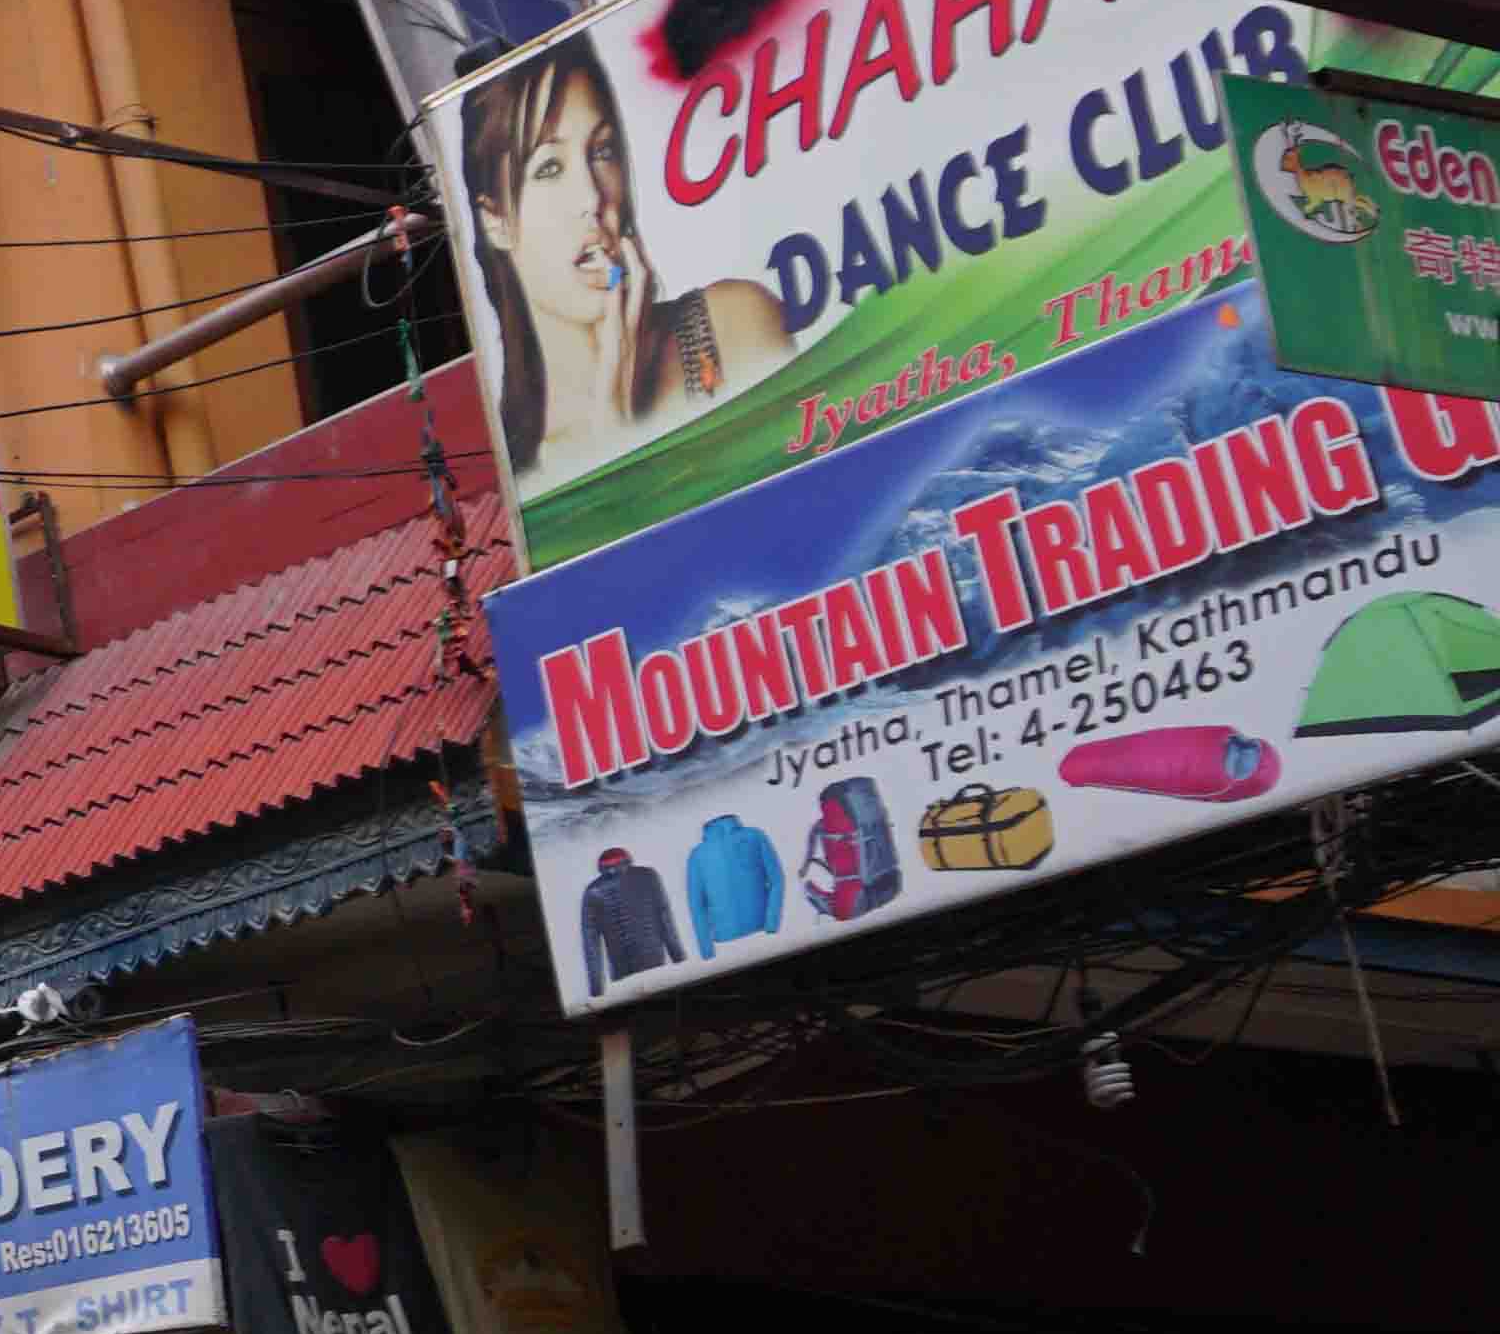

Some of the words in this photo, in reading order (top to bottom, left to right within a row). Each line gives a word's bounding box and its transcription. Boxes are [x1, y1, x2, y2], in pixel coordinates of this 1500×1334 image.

[766, 124, 1047, 336] DANCE
[1069, 4, 1308, 196] CLUB
[534, 545, 970, 792] MOUNTAIN
[950, 393, 1381, 636] TRADING
[766, 716, 926, 792] Jyatha,
[934, 637, 1122, 731] Thamel,
[1137, 530, 1445, 662] Kathmandu
[922, 729, 1005, 784] Tel:
[1018, 639, 1257, 753] 4-250463
[73, 1273, 198, 1334] SHIRT
